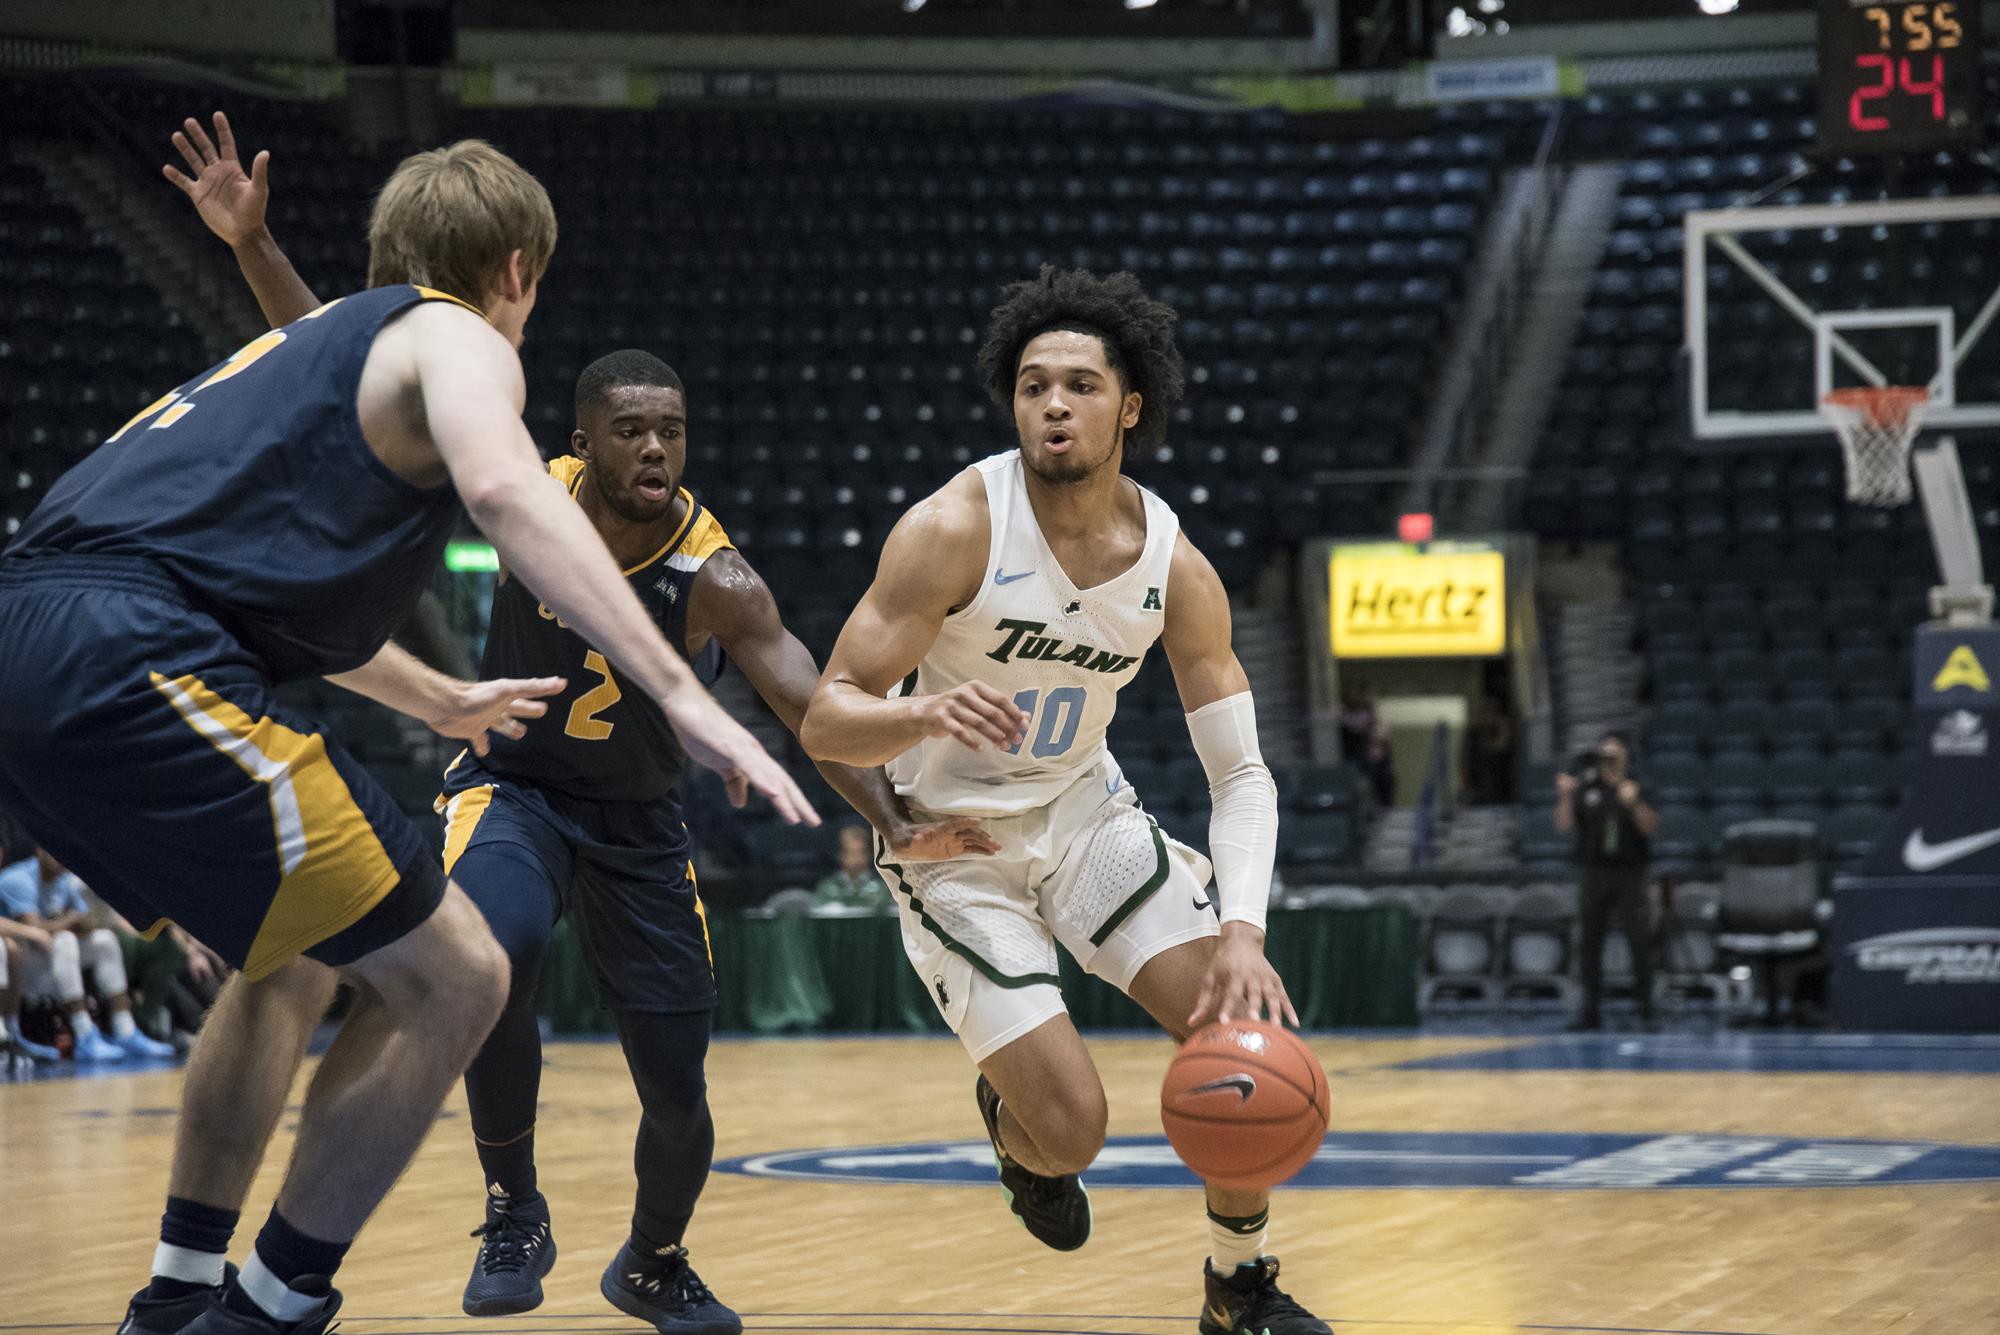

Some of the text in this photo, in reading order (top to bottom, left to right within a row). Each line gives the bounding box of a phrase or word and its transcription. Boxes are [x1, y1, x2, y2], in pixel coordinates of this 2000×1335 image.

[1850, 54, 1945, 131] 24
[1142, 587, 1162, 610] A
[1347, 578, 1487, 620] Hertz
[564, 649, 622, 740] 2
[1006, 686, 1088, 759] 10
